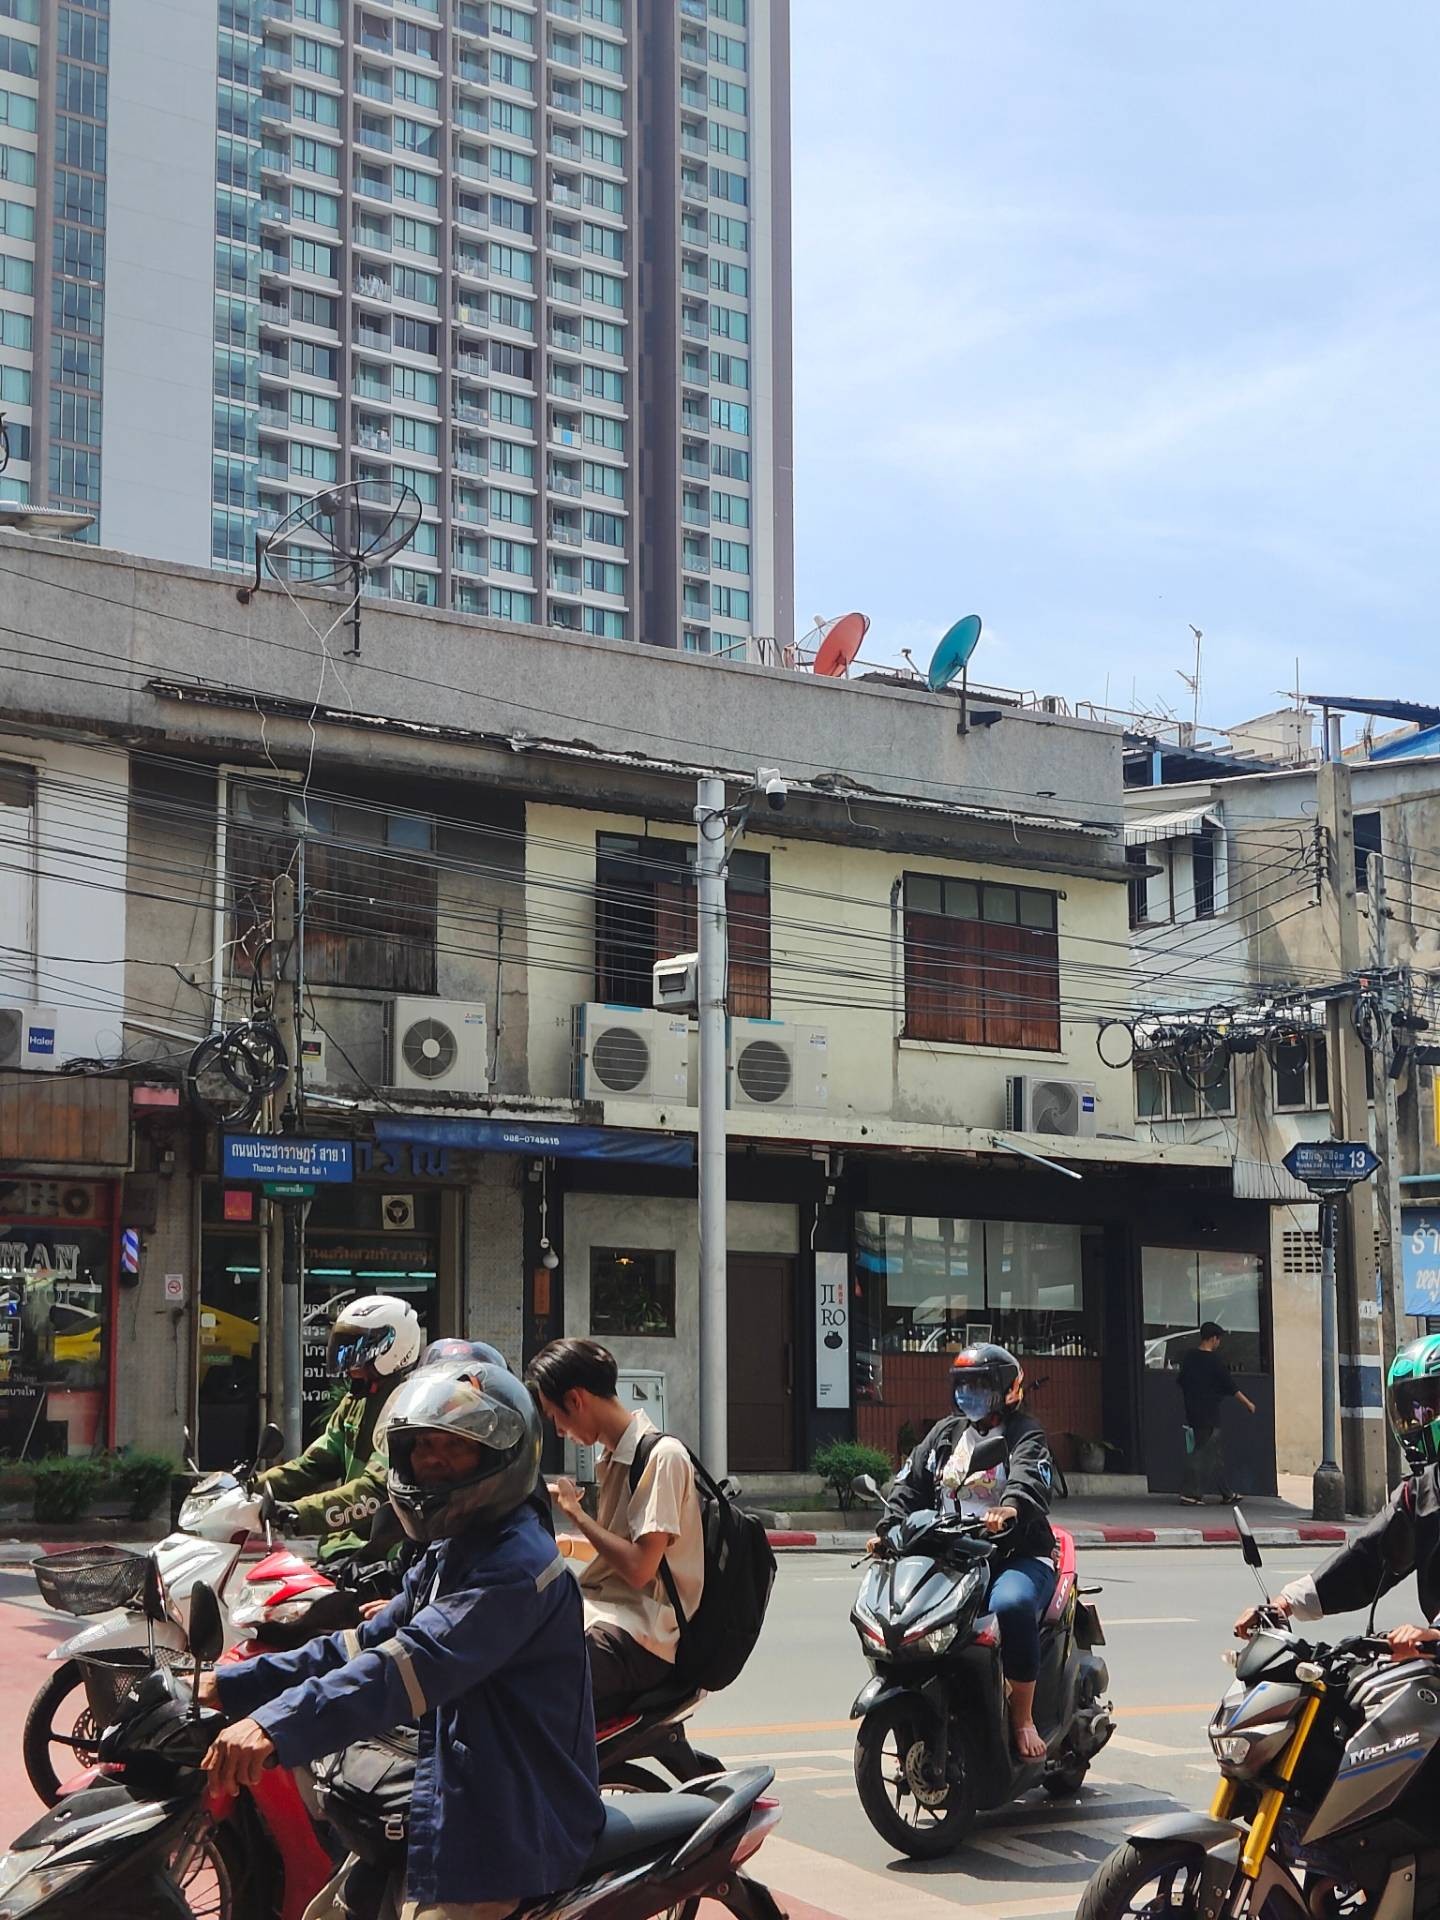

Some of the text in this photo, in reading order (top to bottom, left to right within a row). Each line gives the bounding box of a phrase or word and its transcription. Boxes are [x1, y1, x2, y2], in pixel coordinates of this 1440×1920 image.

[231, 1142, 346, 1164] ถนนประชาราษฎร์ สาย 1
[1349, 1150, 1367, 1169] 13
[252, 1163, 275, 1173] Thanon
[277, 1165, 297, 1174] Pracha
[323, 1167, 327, 1175] 1
[1412, 1218, 1440, 1255] ร้า
[820, 1284, 836, 1305] JI
[820, 1308, 846, 1326] RO
[325, 1494, 380, 1527] Grab
